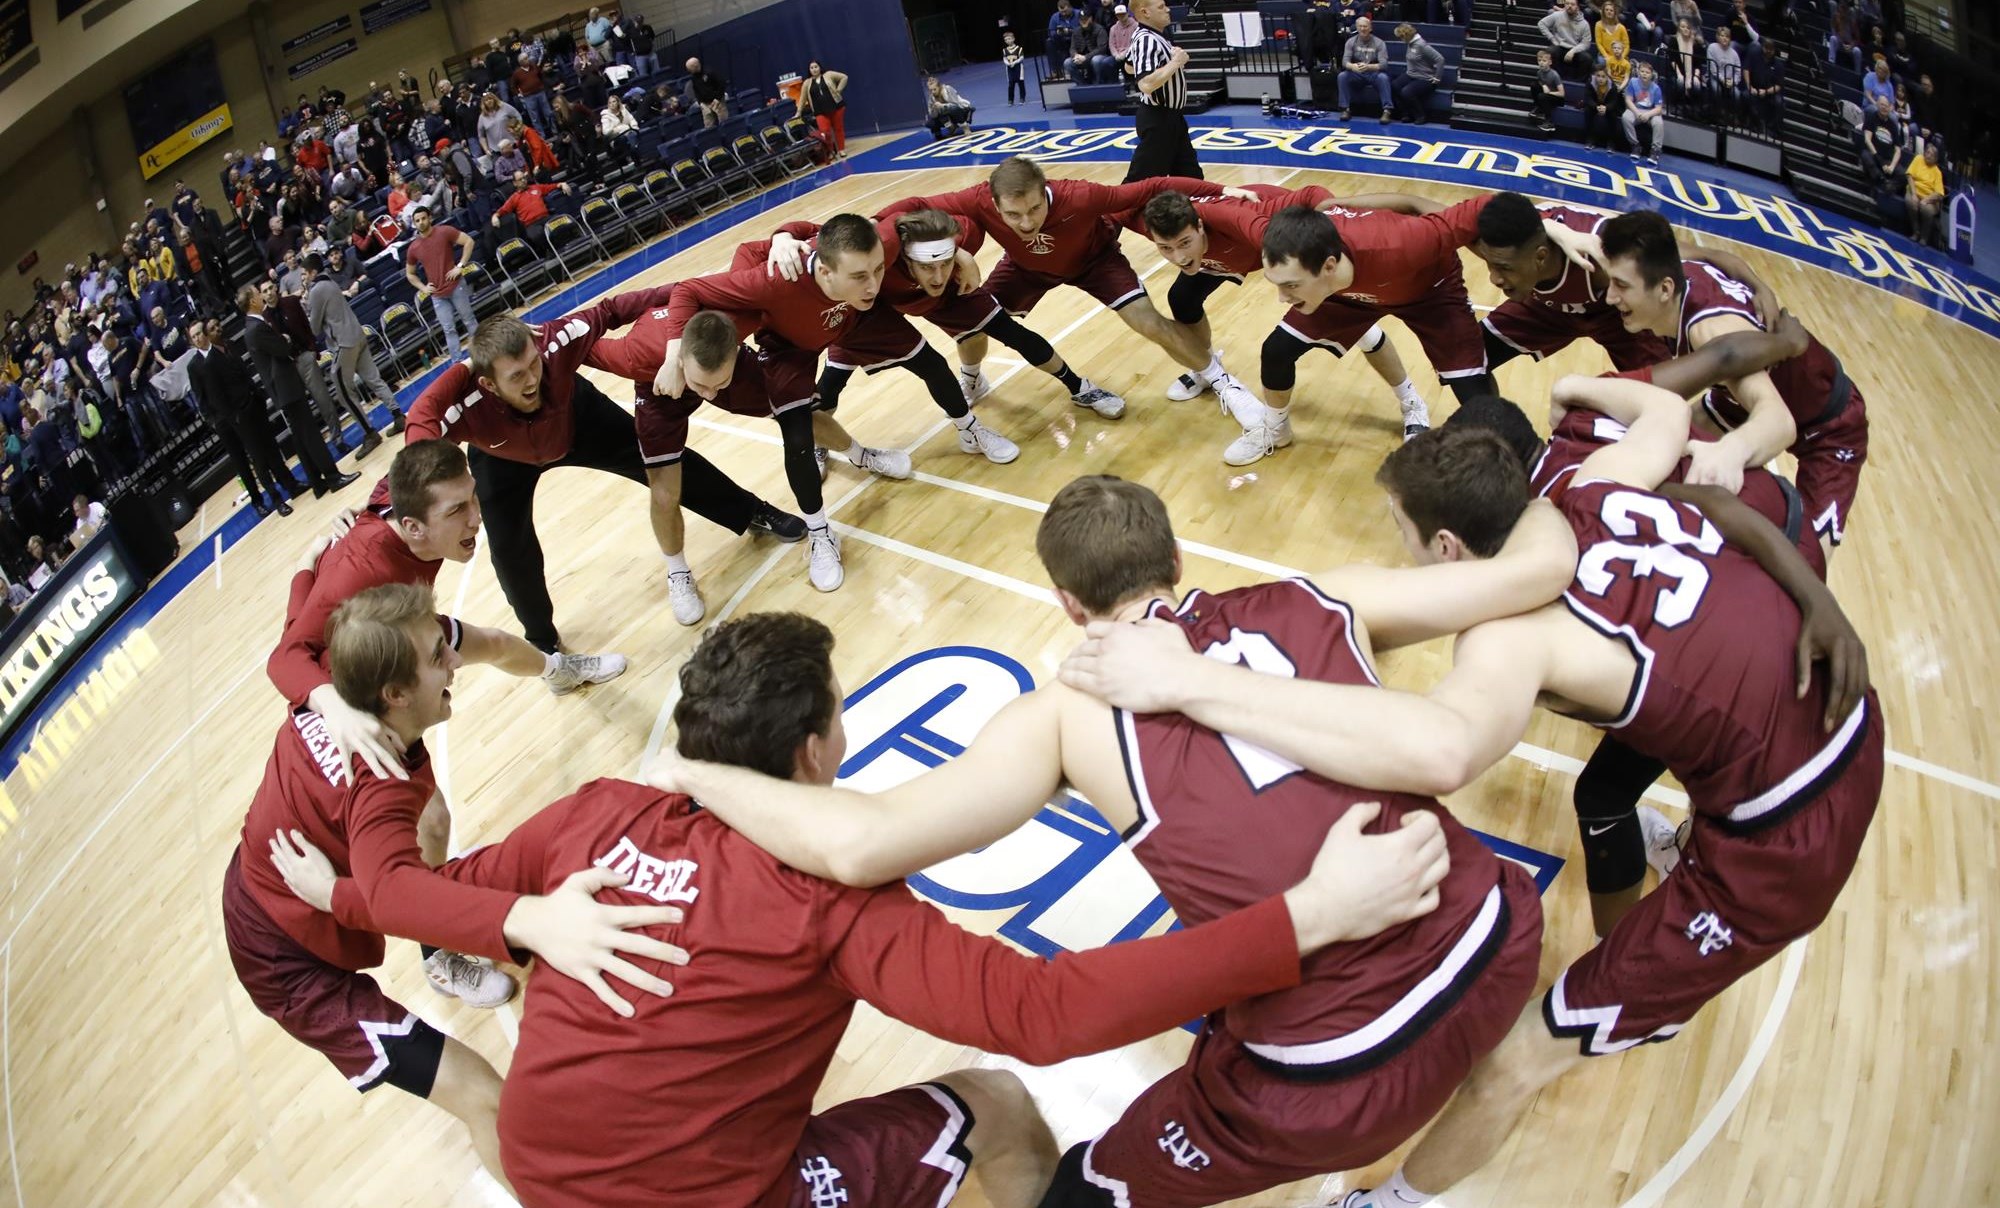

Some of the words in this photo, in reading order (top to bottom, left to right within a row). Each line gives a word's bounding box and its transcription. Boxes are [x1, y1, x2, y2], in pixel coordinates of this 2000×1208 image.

[890, 127, 1627, 196] Augstana
[1576, 490, 1725, 629] 32
[0, 561, 118, 724] IKINGS
